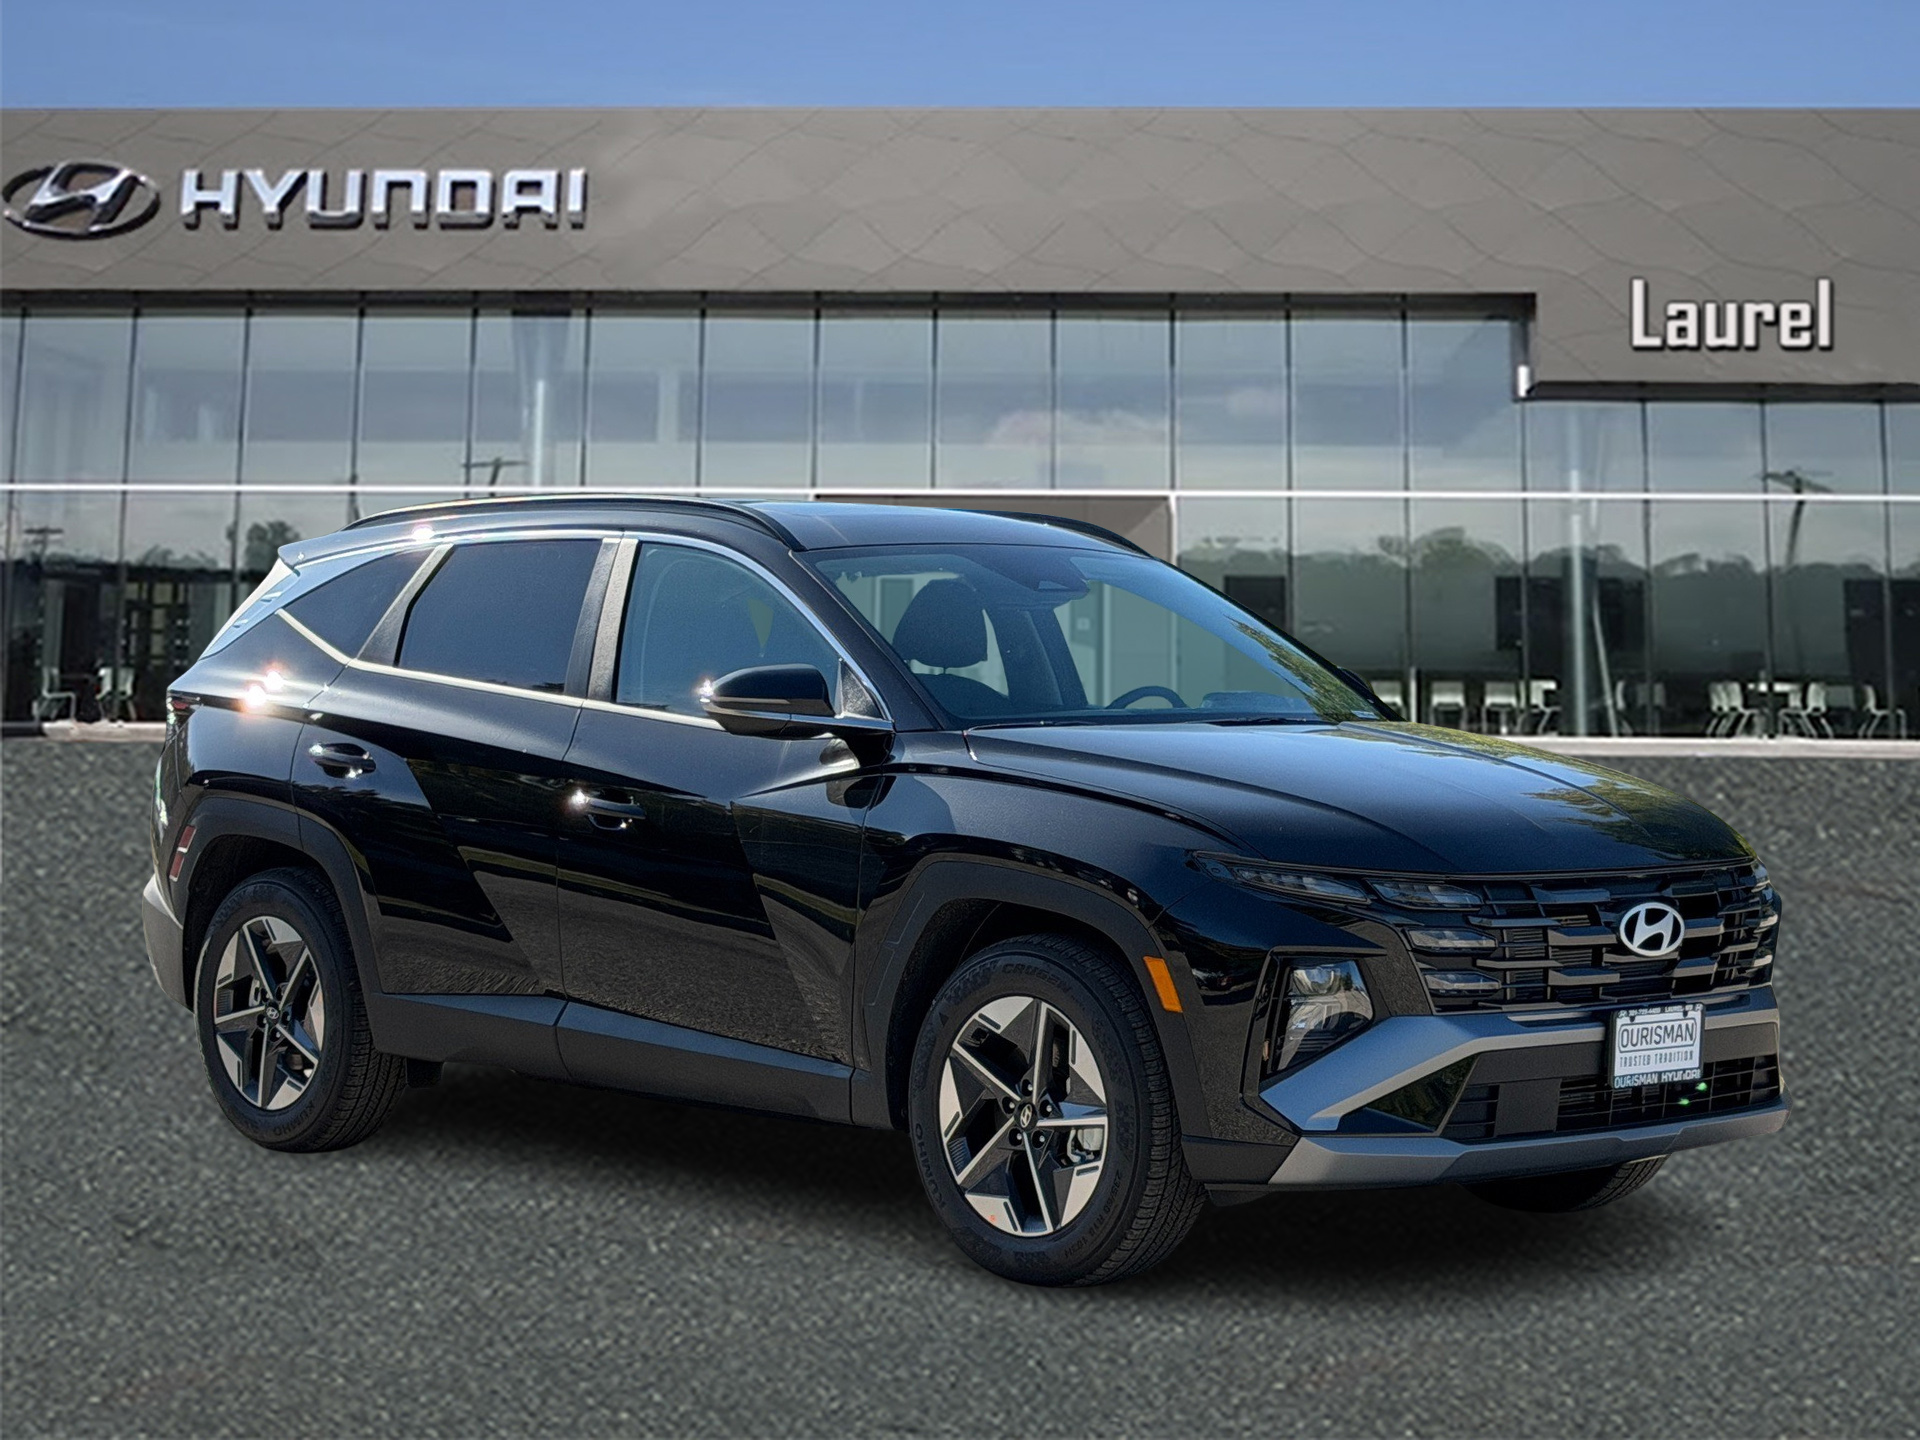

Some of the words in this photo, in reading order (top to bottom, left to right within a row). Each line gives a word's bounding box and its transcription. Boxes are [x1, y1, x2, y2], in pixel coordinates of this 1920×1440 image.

[180, 168, 588, 230] HYUNDAI
[1631, 278, 1832, 349] Laurel
[1620, 1023, 1694, 1048] OURISMAN
[1619, 1054, 1651, 1068] TRUSTED
[1655, 1050, 1694, 1064] TRADITION
[1614, 1073, 1658, 1089] OURISMAN
[1661, 1069, 1701, 1082] HYUNDAI
